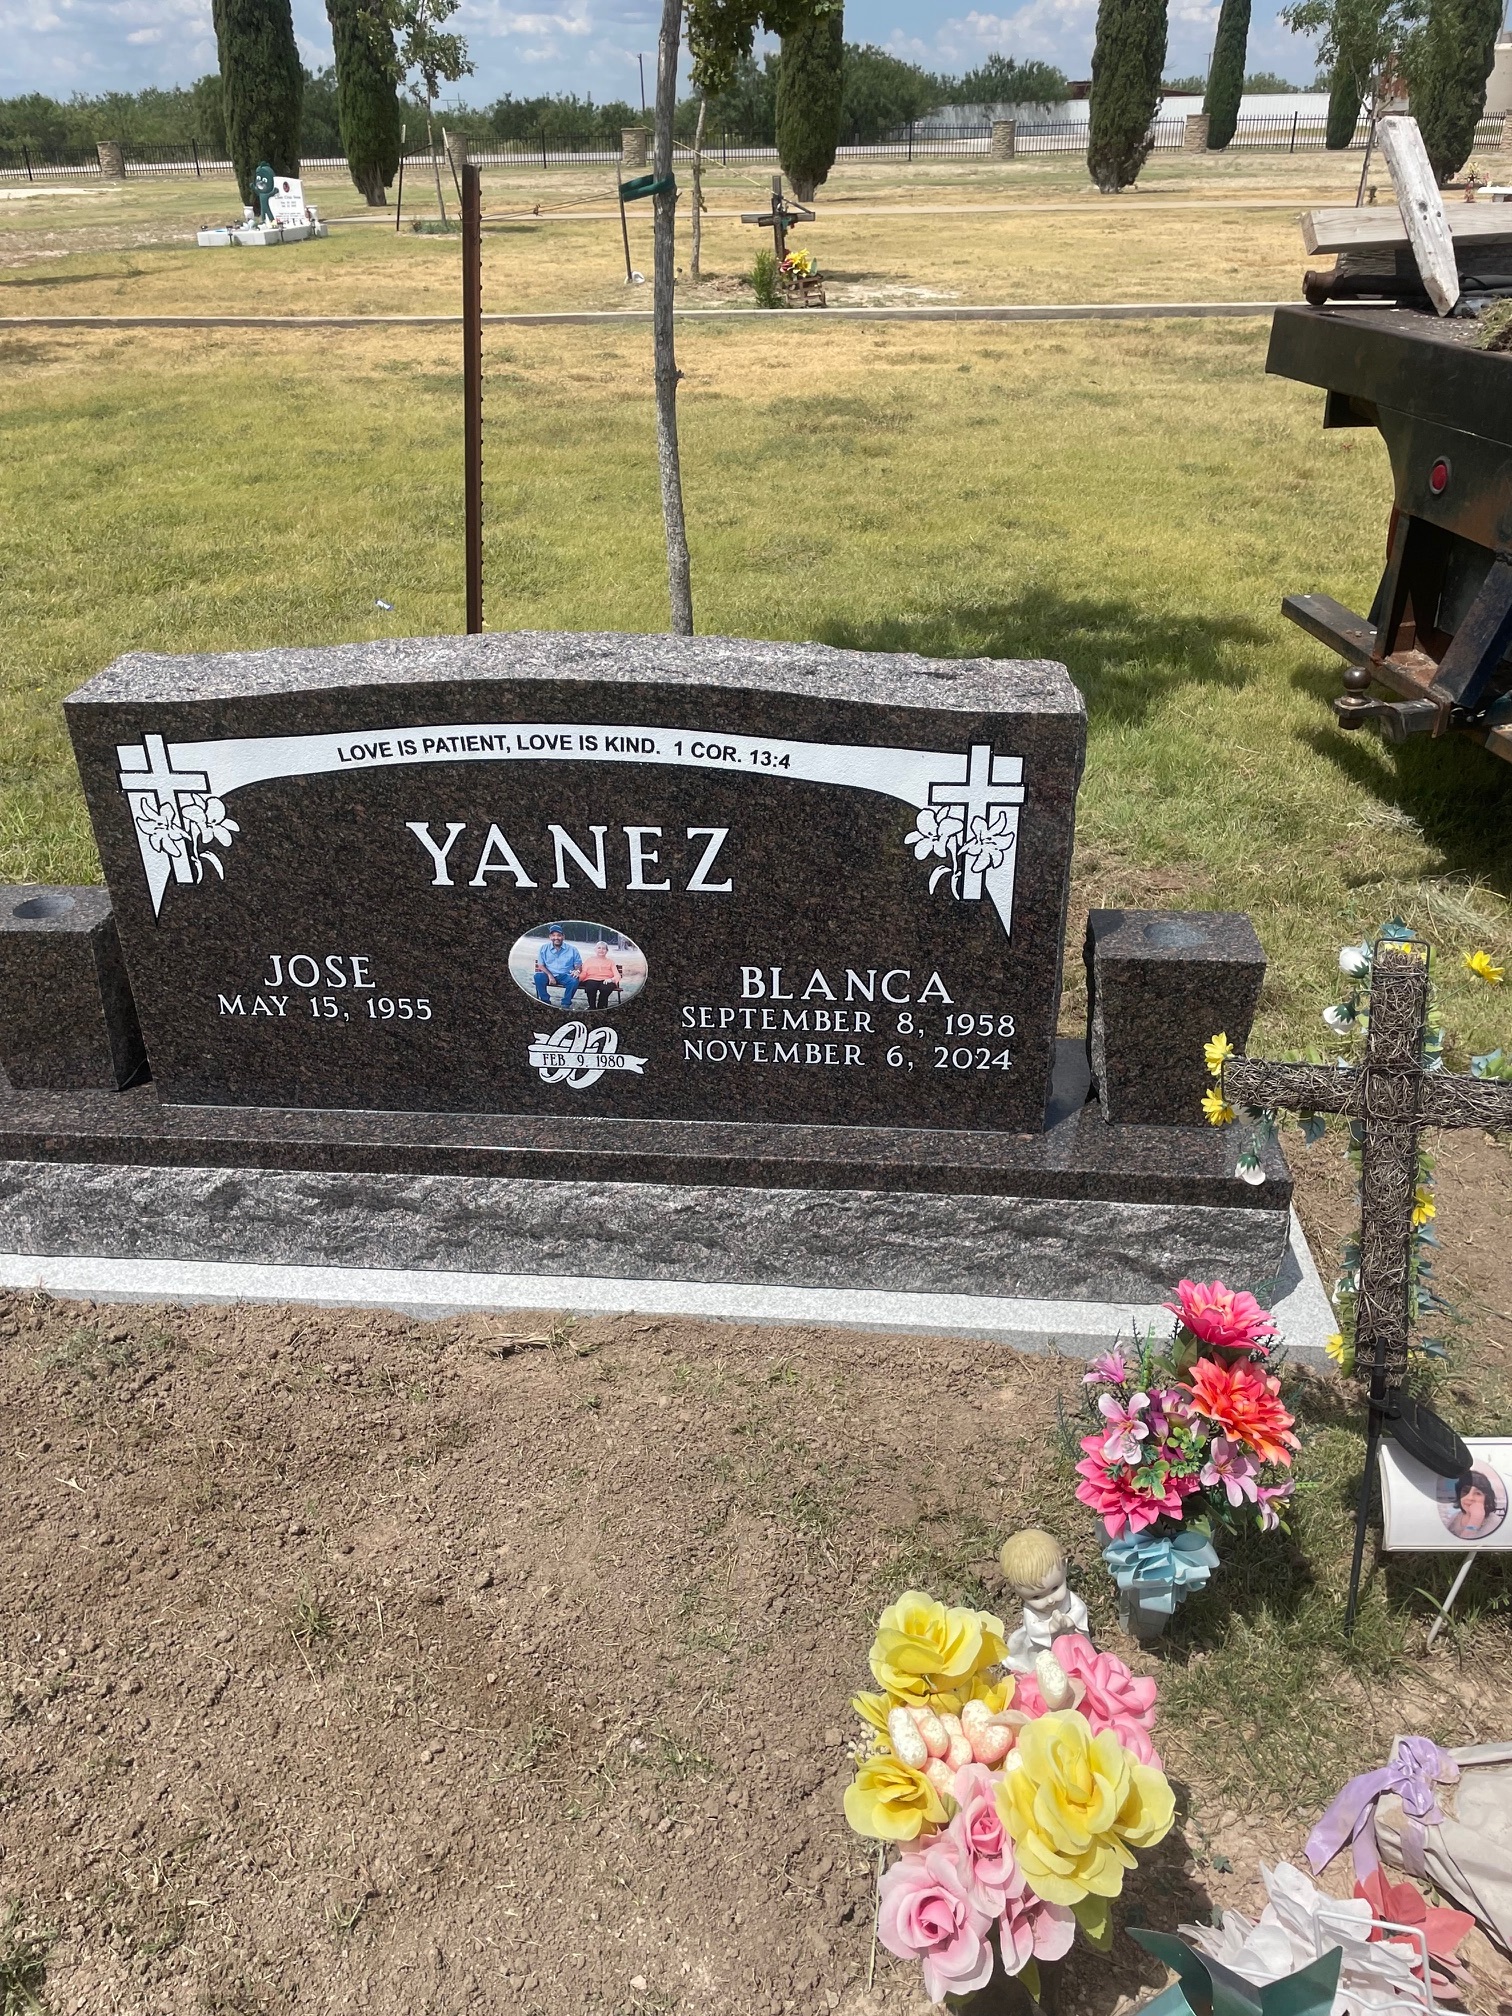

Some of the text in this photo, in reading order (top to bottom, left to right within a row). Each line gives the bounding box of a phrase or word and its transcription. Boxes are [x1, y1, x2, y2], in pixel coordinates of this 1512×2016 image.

[337, 734, 791, 770] LOVE IS PATIENT, LOVE IS KIND. 1 COR. 13:4
[405, 821, 734, 892] YANEZ
[264, 954, 377, 989] JOSE
[739, 966, 955, 1004] BLANCA
[217, 994, 433, 1022] MAY 15, 1955
[681, 1006, 1016, 1039] SEPTEMBER 8, 1958
[596, 1054, 625, 1068] 1980
[683, 1039, 1013, 1072] NOVEMBER 6, 2024
